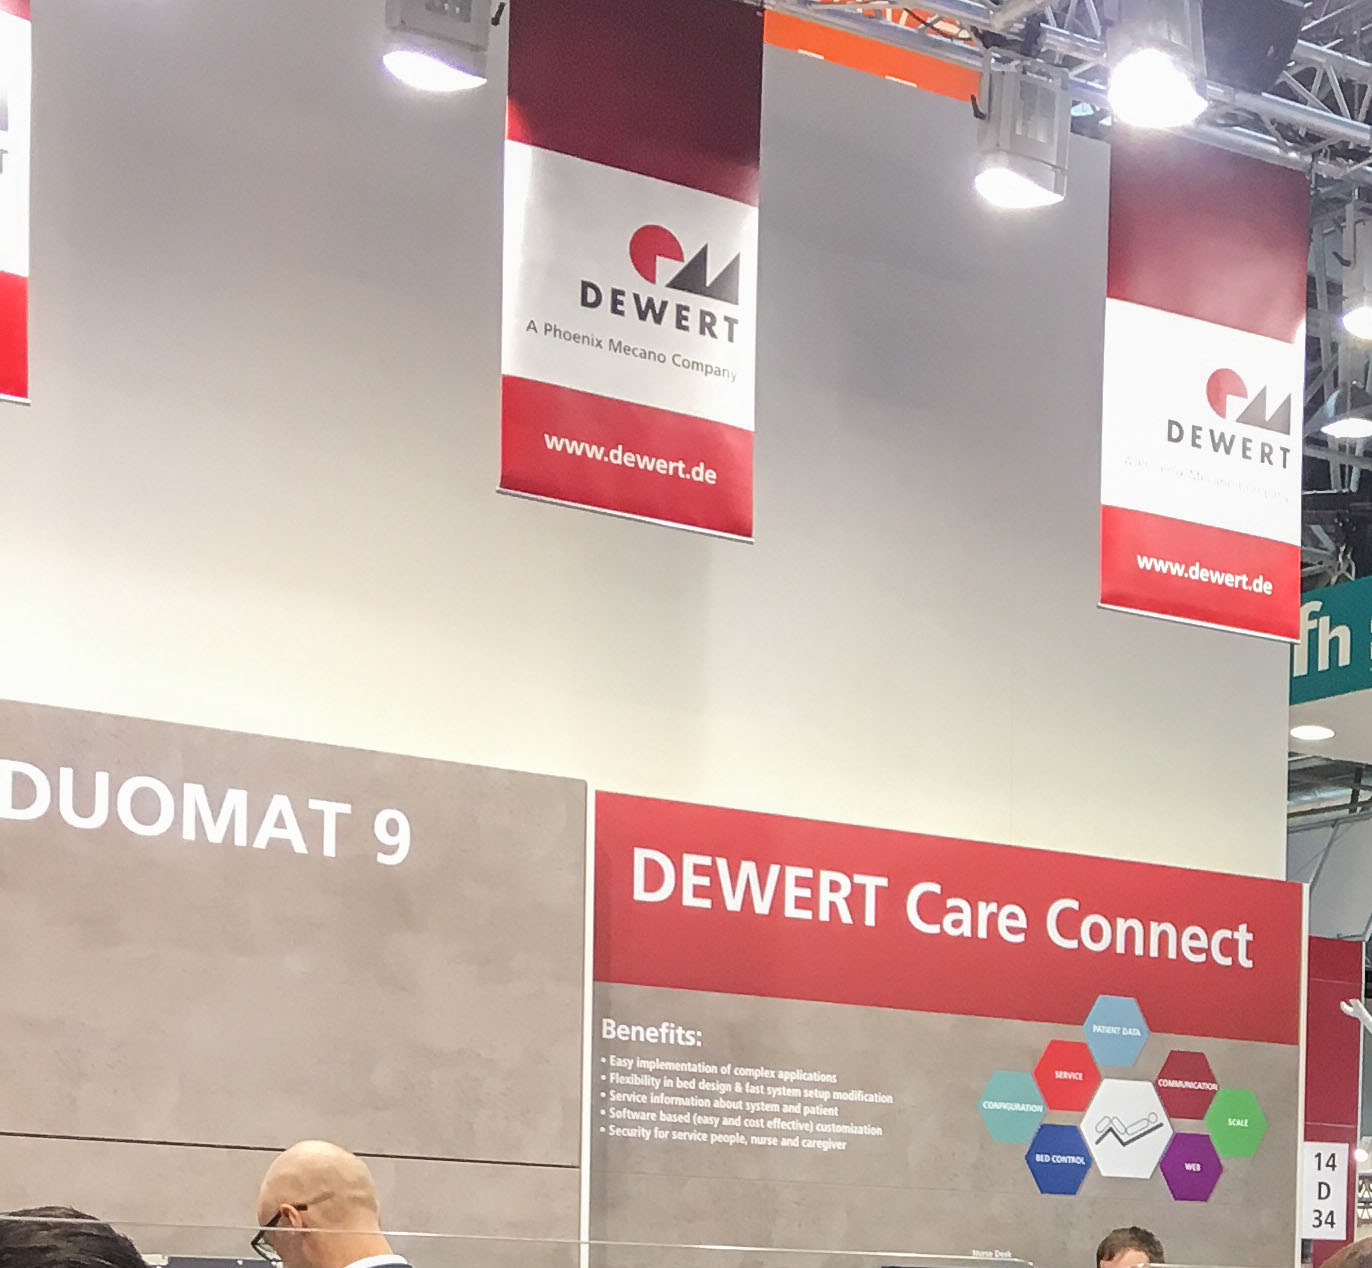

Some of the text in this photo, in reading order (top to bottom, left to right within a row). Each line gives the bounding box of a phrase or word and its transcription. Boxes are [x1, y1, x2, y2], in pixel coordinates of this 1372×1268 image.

[580, 280, 739, 343] DEWERT
[526, 319, 737, 383] A Phoenix Mecano Company
[543, 433, 717, 484] www.dewert.de
[1167, 419, 1291, 469] DEWERT
[1136, 554, 1273, 595] www.dewert.de
[0, 758, 411, 866] DUOMAT 9
[632, 846, 1254, 969] DEWERT Care Connect
[601, 1018, 703, 1047] Benefits:
[1092, 1024, 1142, 1037] PATIENT DATA
[609, 1054, 838, 1084] Easy implementation of complex applications
[1054, 1070, 1084, 1081] SERVICE
[609, 1072, 894, 1104] Flexibility in bed design & fast system setup modification
[1157, 1078, 1219, 1091] COMMUNICATION
[609, 1089, 839, 1118] Service information about system and patient
[982, 1100, 1044, 1113] CONFIGURATION
[609, 1106, 883, 1136] Software based (easy and cost effective) customization
[1227, 1117, 1249, 1128] SCALE
[609, 1124, 847, 1152] Security for service people, nurse and caregiver
[1035, 1153, 1086, 1165] BED CONTROL
[1184, 1162, 1202, 1172] WEB
[1314, 1152, 1337, 1172] 14
[1318, 1182, 1331, 1201] D
[1312, 1209, 1336, 1229] 34
